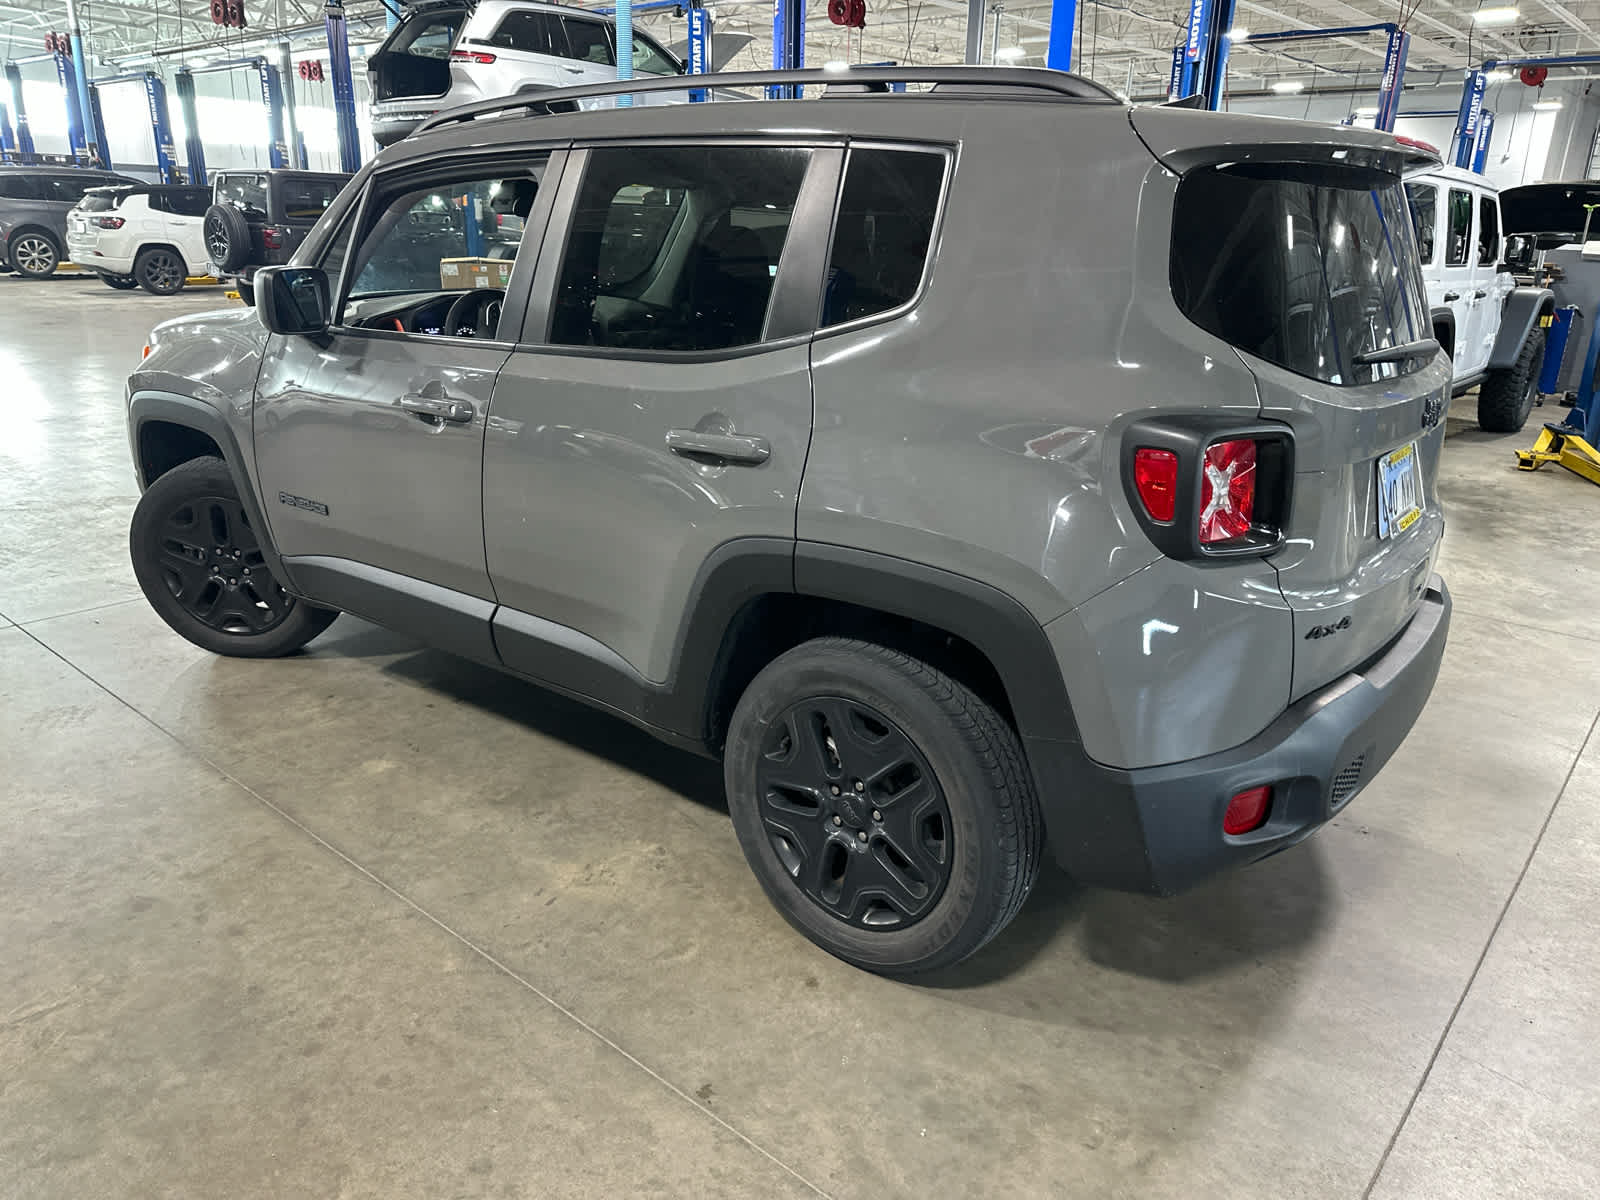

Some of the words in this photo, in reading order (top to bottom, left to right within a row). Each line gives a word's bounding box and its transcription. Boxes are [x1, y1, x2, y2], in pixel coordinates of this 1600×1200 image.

[692, 11, 702, 35] LIFT
[1190, 0, 1203, 48] ROTAR
[692, 38, 702, 75] OTARY
[1466, 93, 1480, 130] ROTARY
